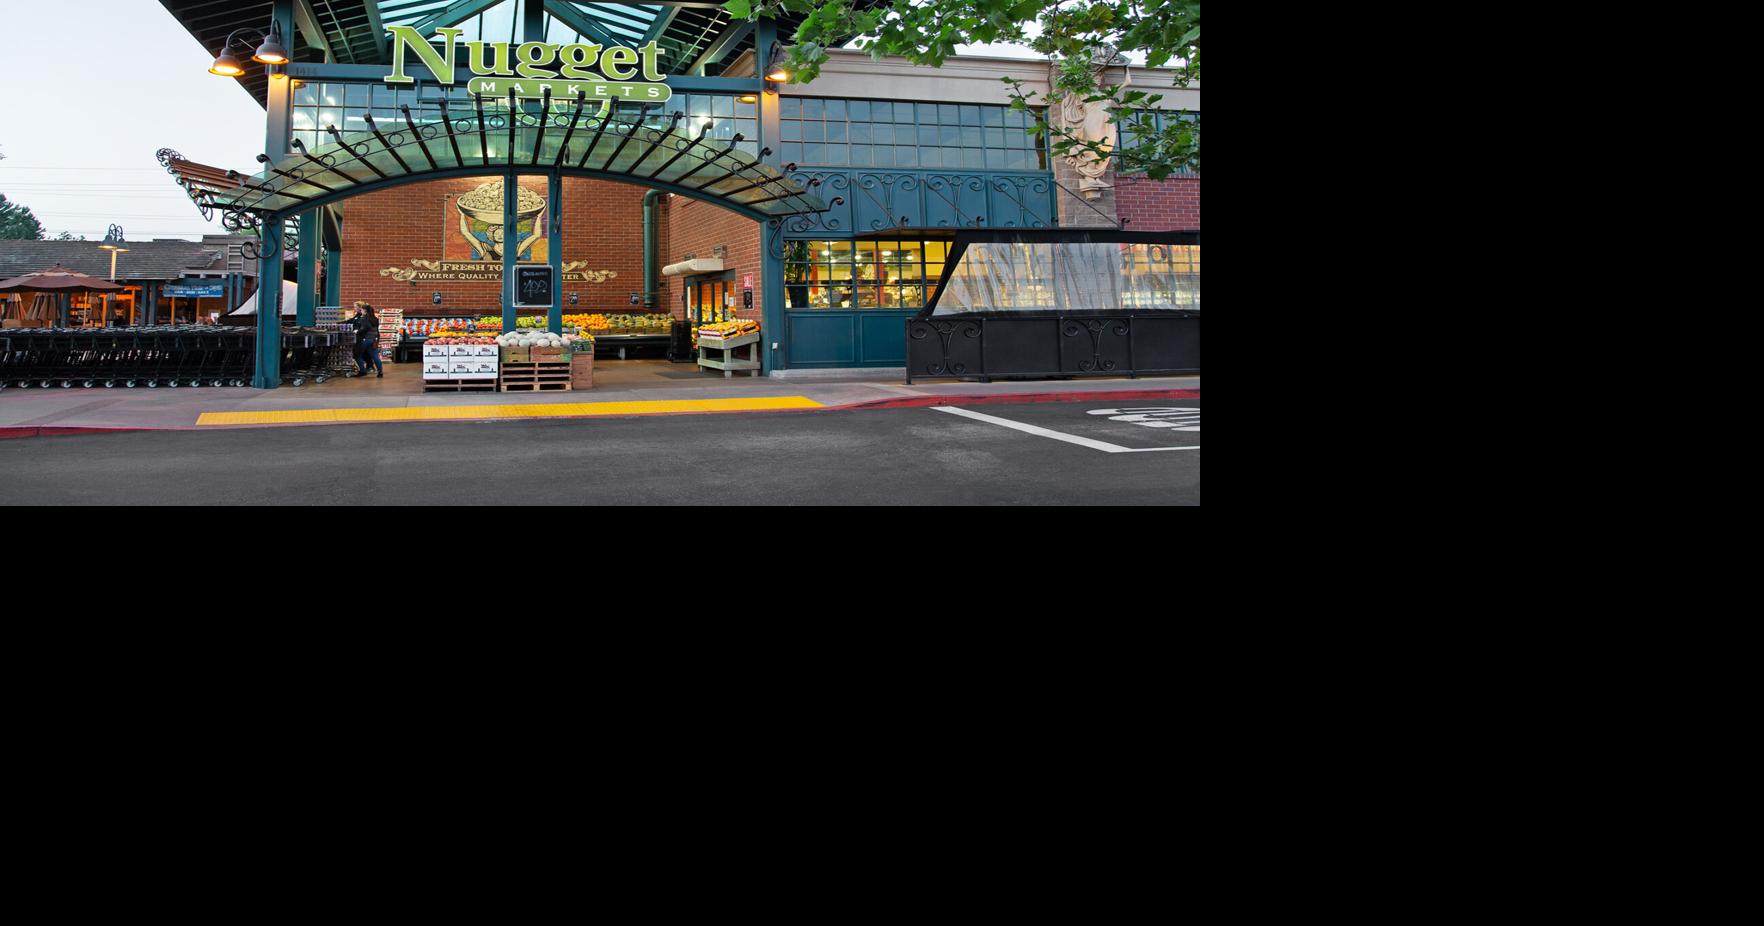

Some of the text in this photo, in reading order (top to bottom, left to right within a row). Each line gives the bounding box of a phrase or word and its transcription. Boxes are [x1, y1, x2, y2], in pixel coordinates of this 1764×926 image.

[383, 25, 668, 85] Nugget
[480, 81, 661, 97] MARKETS
[442, 263, 502, 272] FRESH TO
[418, 272, 579, 281] WHERE QUALITY TER
